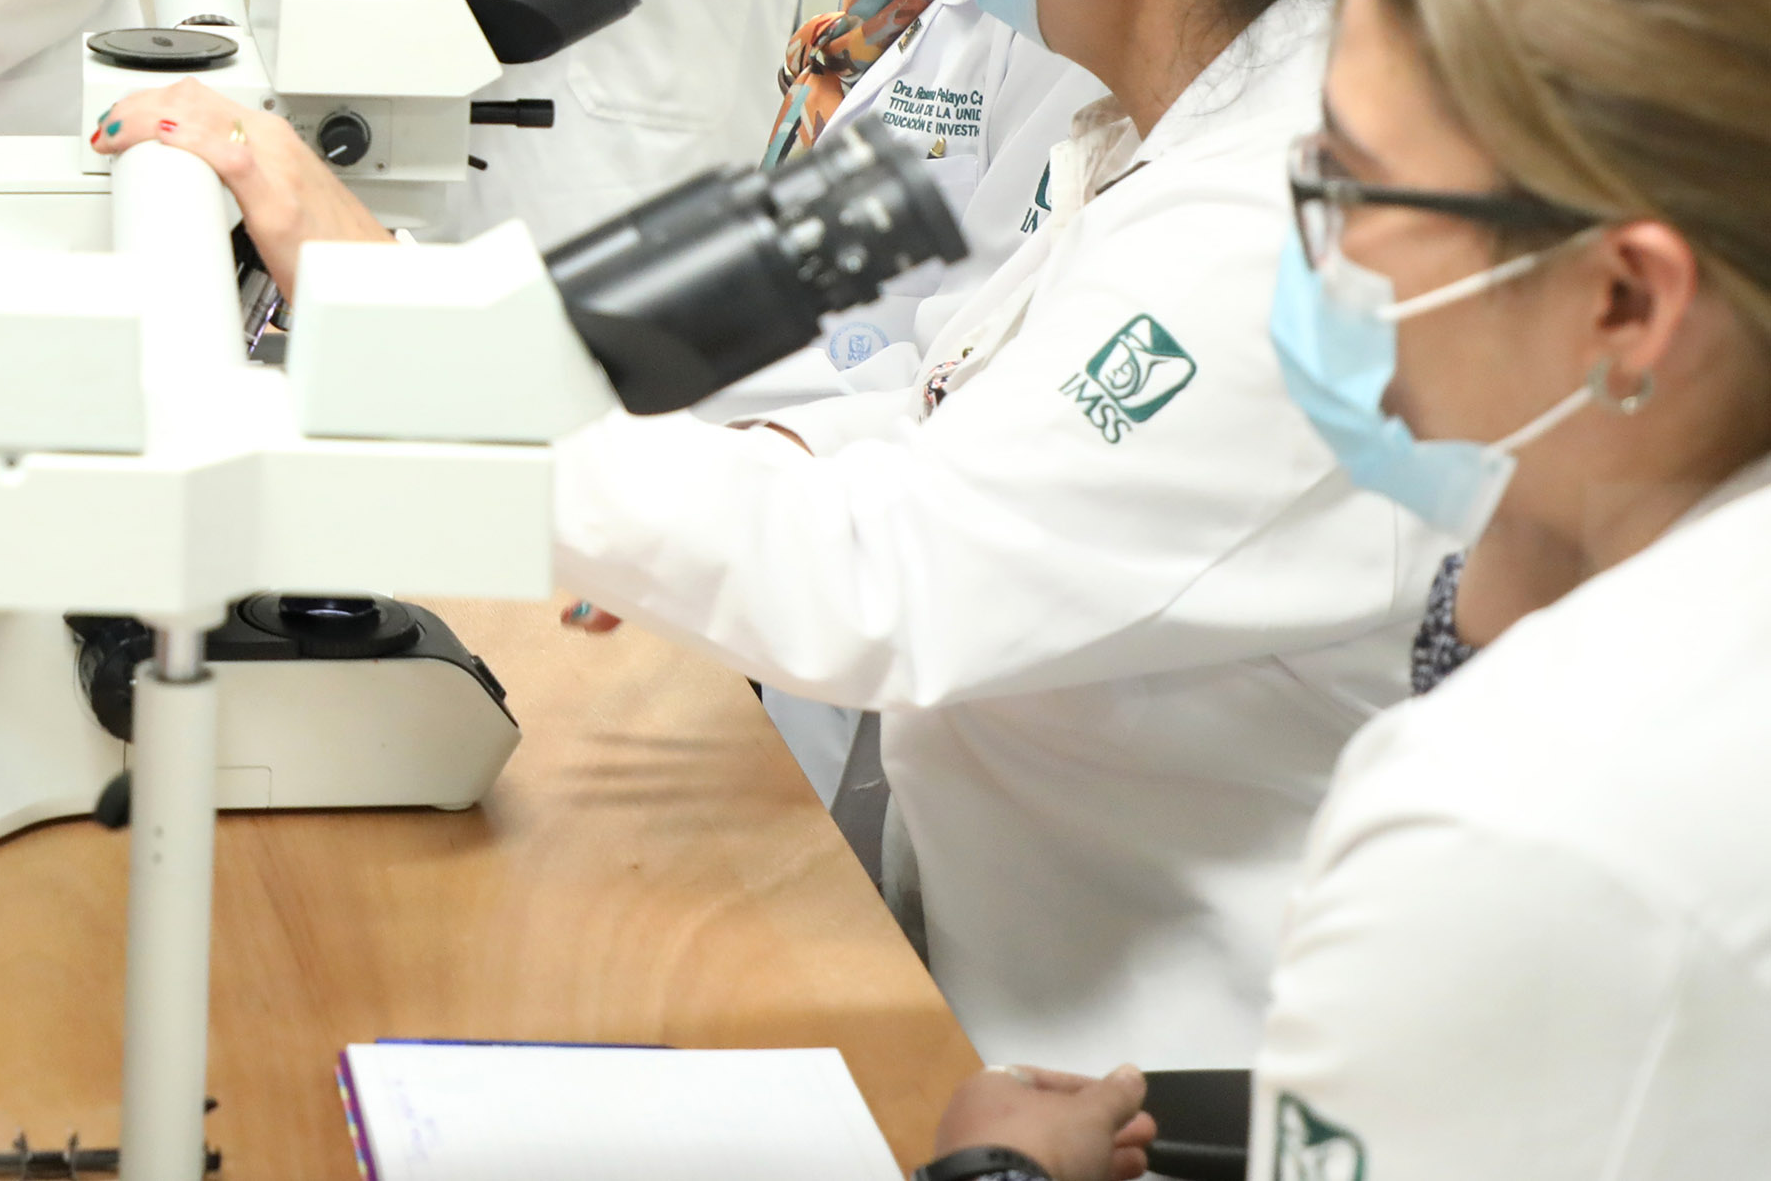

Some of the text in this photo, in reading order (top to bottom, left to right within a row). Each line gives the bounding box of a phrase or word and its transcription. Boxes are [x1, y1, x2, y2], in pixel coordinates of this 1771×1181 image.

[893, 80, 913, 98] Dra.
[936, 106, 951, 120] LA
[926, 121, 933, 133] E
[1058, 372, 1133, 444] IMSS
